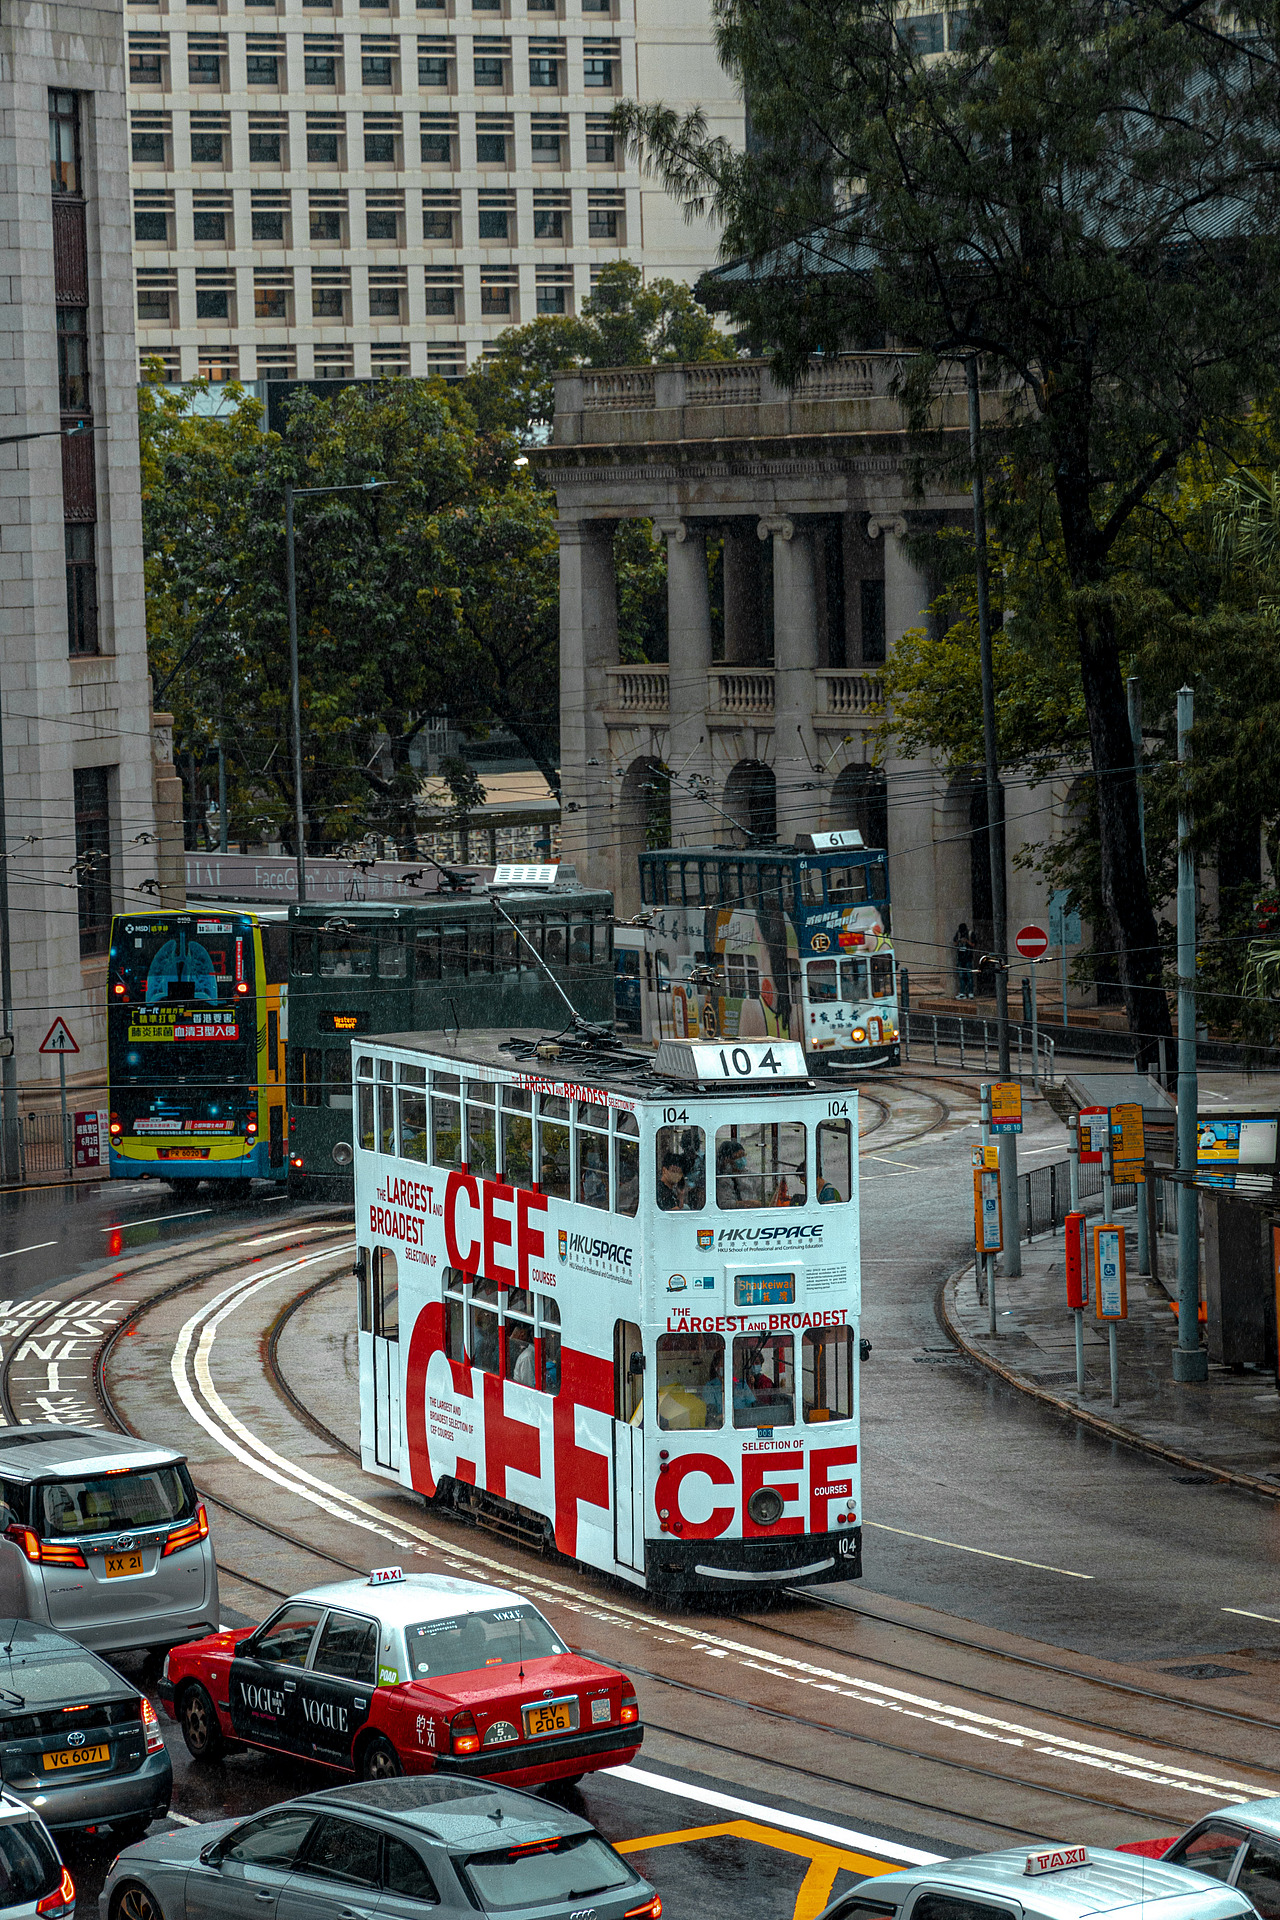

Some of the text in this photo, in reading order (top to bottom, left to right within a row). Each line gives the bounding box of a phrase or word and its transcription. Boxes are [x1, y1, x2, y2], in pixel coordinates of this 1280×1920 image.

[830, 834, 844, 846] 61
[799, 861, 808, 869] 61
[294, 907, 300, 917] 3
[393, 909, 400, 919] 3
[719, 1047, 782, 1077] 104
[662, 1107, 690, 1124] 104
[828, 1101, 849, 1117] 104
[170, 1148, 200, 1157] PR 6020
[376, 1175, 443, 1217] THE LARGEST AND
[370, 1204, 425, 1247] BROADEST
[444, 1171, 548, 1291] CEF
[405, 1246, 437, 1268] SELECTION OF
[532, 1268, 557, 1288] COURSES
[667, 1309, 848, 1333] LARGEST AND BROADEST
[672, 1307, 690, 1318] THE
[437, 1399, 452, 1414] LARGEST
[453, 1405, 461, 1417] AND
[429, 1410, 448, 1426] BROADEST
[448, 1417, 468, 1433] SELECTION
[437, 1426, 454, 1442] COURSES
[758, 1429, 772, 1437] 003
[742, 1439, 804, 1452] SELECTION OF
[654, 1444, 858, 1540] CEF
[814, 1484, 848, 1497] COURSES
[838, 1538, 857, 1555] 104
[108, 1557, 141, 1572] XX 21
[376, 1569, 402, 1581] TAXI
[379, 1669, 397, 1683] POAD
[240, 1682, 286, 1716] VOGUE
[302, 1697, 349, 1732] VOGUE
[540, 1706, 557, 1720] EV
[416, 1714, 436, 1732] 的士
[535, 1716, 565, 1733] 206
[490, 1734, 512, 1743] SEATS
[497, 1728, 504, 1736] 5
[50, 1748, 103, 1767] VG 6071
[1037, 1848, 1086, 1870] TAXI
